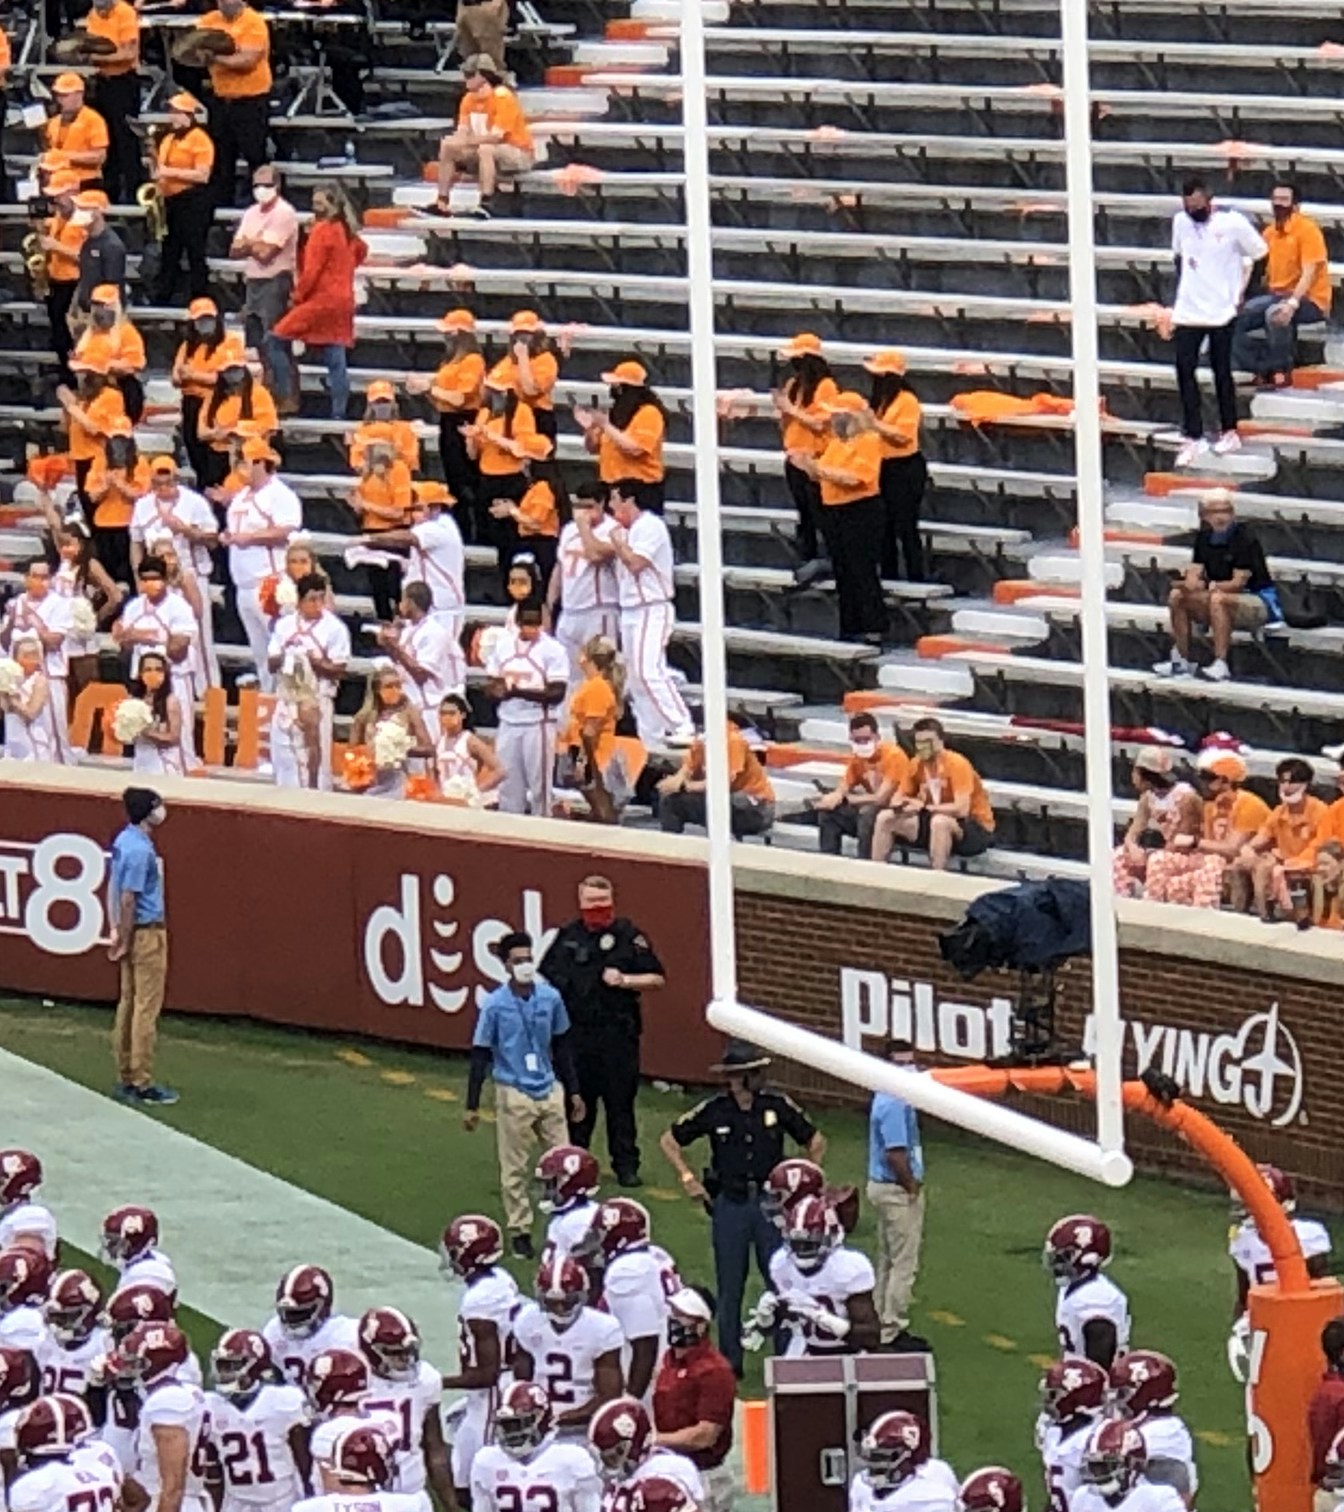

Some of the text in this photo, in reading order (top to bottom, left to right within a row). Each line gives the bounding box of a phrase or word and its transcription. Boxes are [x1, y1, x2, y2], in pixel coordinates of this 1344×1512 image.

[840, 967, 1017, 1060] Pilot
[1082, 1013, 1243, 1105] YING
[545, 1353, 575, 1403] 2
[222, 1430, 276, 1486] 21
